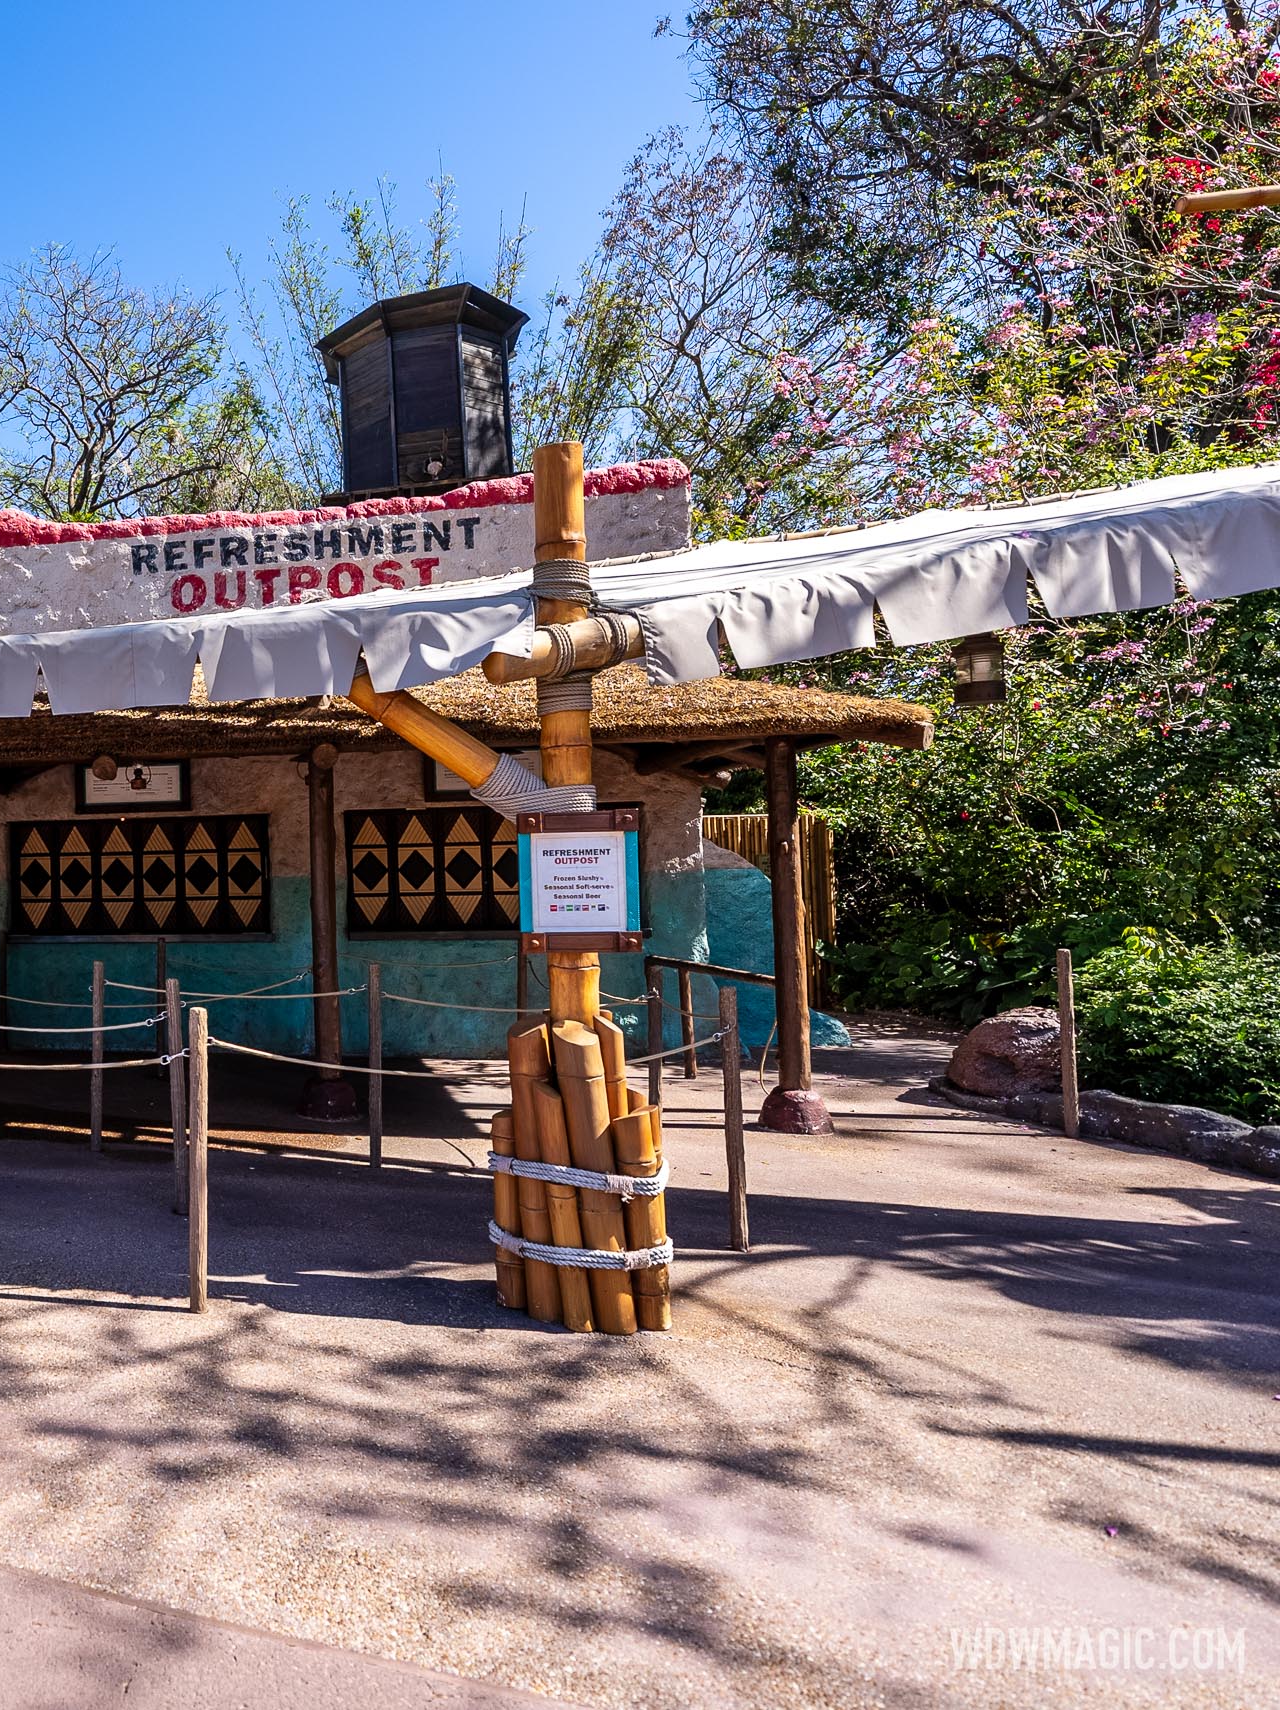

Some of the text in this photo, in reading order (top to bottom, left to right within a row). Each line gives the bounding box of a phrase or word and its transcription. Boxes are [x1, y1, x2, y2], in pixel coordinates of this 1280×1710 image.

[131, 517, 480, 575] REFRESHMENT
[172, 557, 439, 612] OUTPOST
[542, 849, 611, 857] REFRESHMENT
